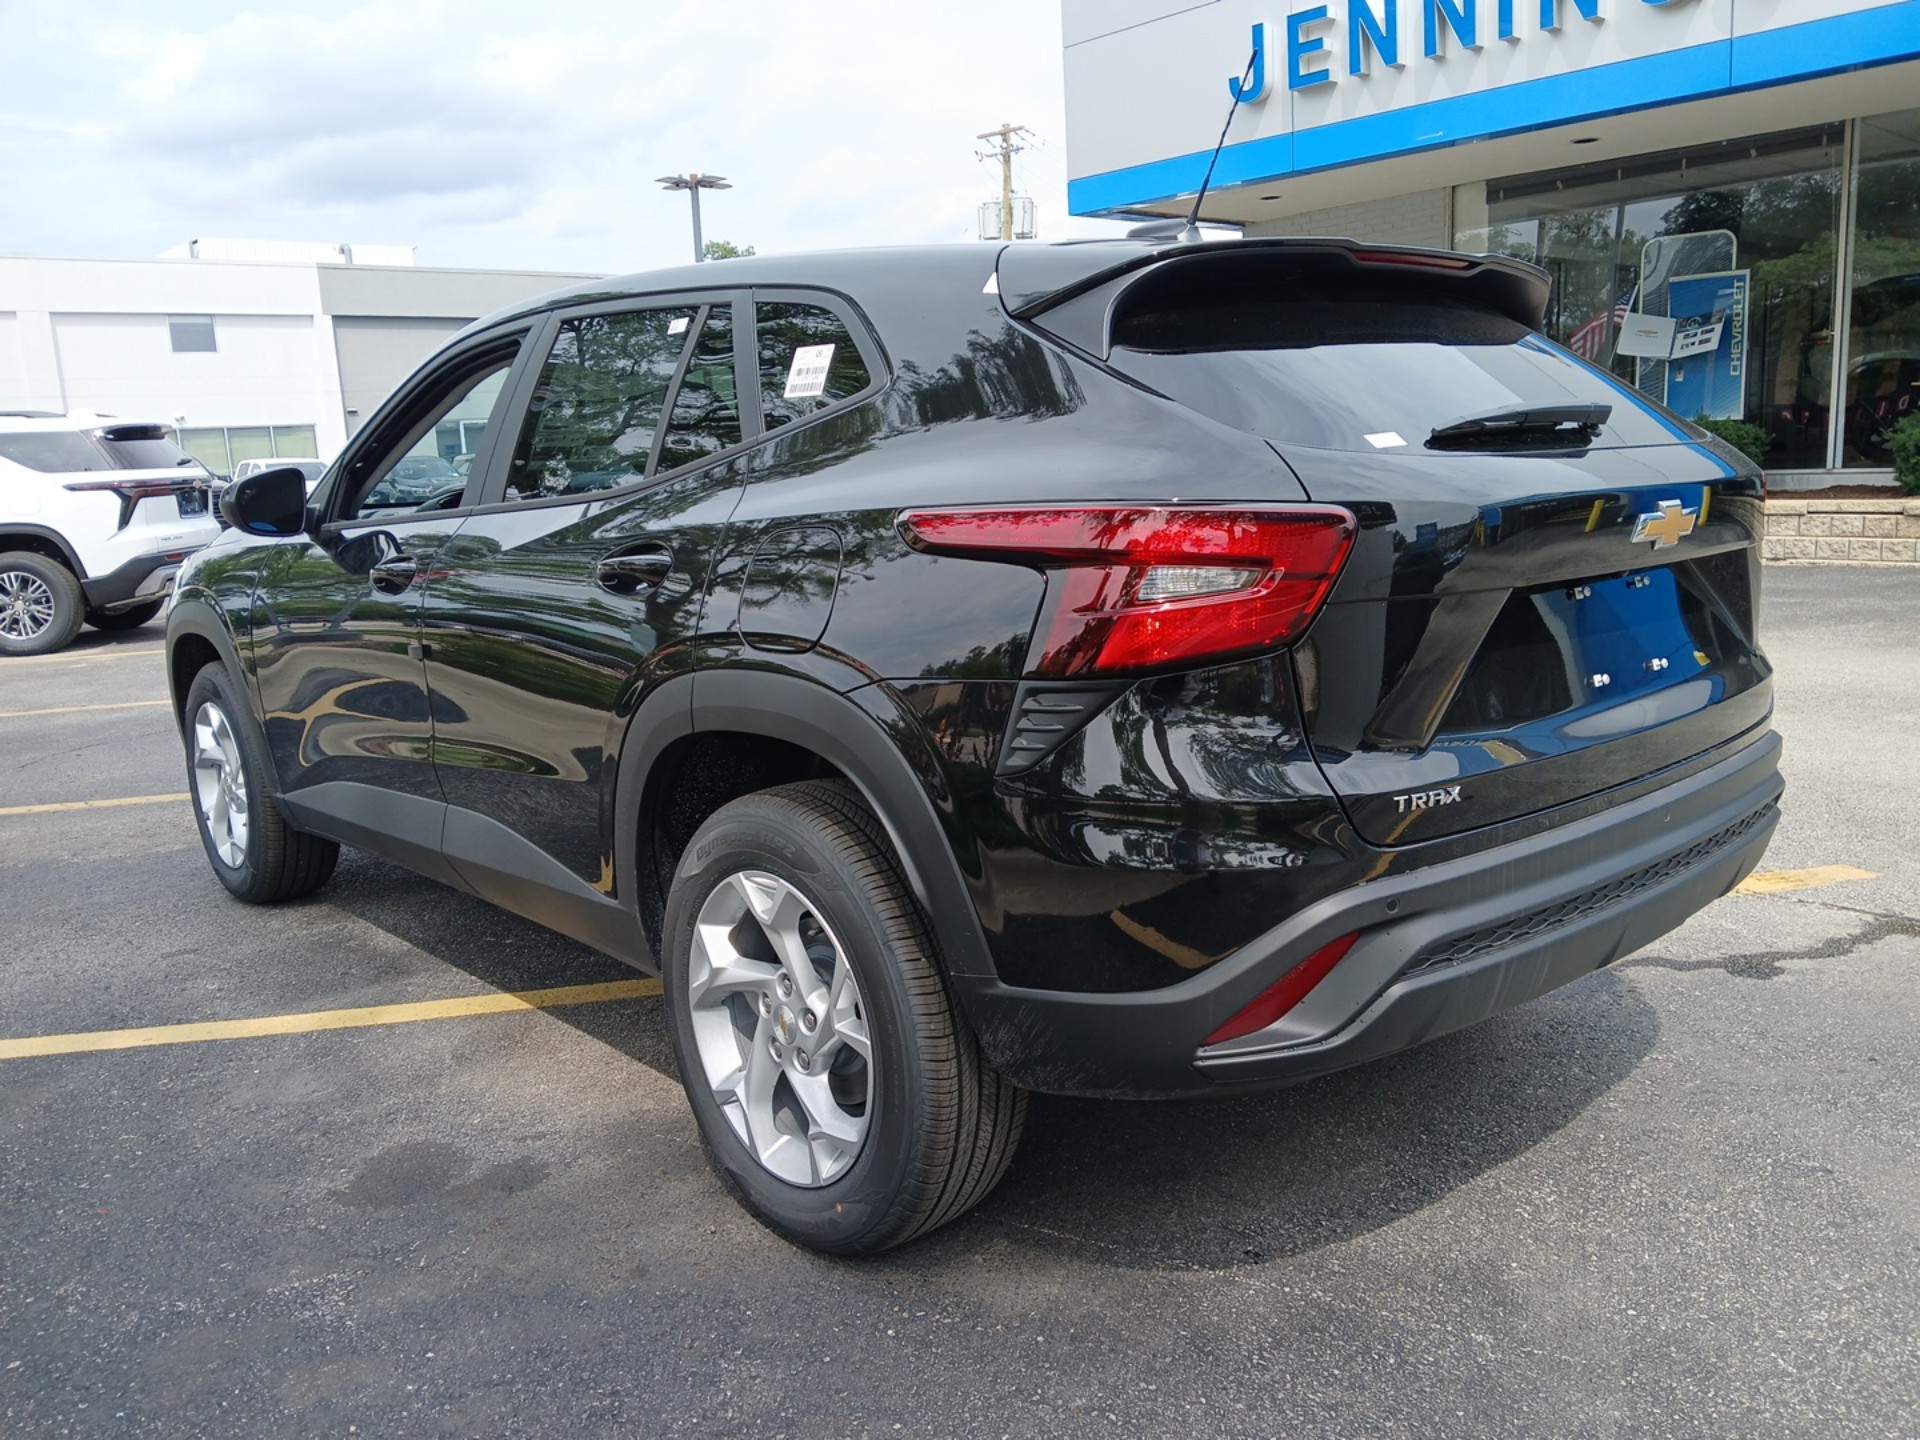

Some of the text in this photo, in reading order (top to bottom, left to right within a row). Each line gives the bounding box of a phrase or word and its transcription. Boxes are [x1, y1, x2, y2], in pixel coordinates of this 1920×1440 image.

[1228, 0, 1672, 105] JENNI
[1730, 279, 1745, 376] CHEVROLET
[1392, 785, 1462, 813] TRAX
